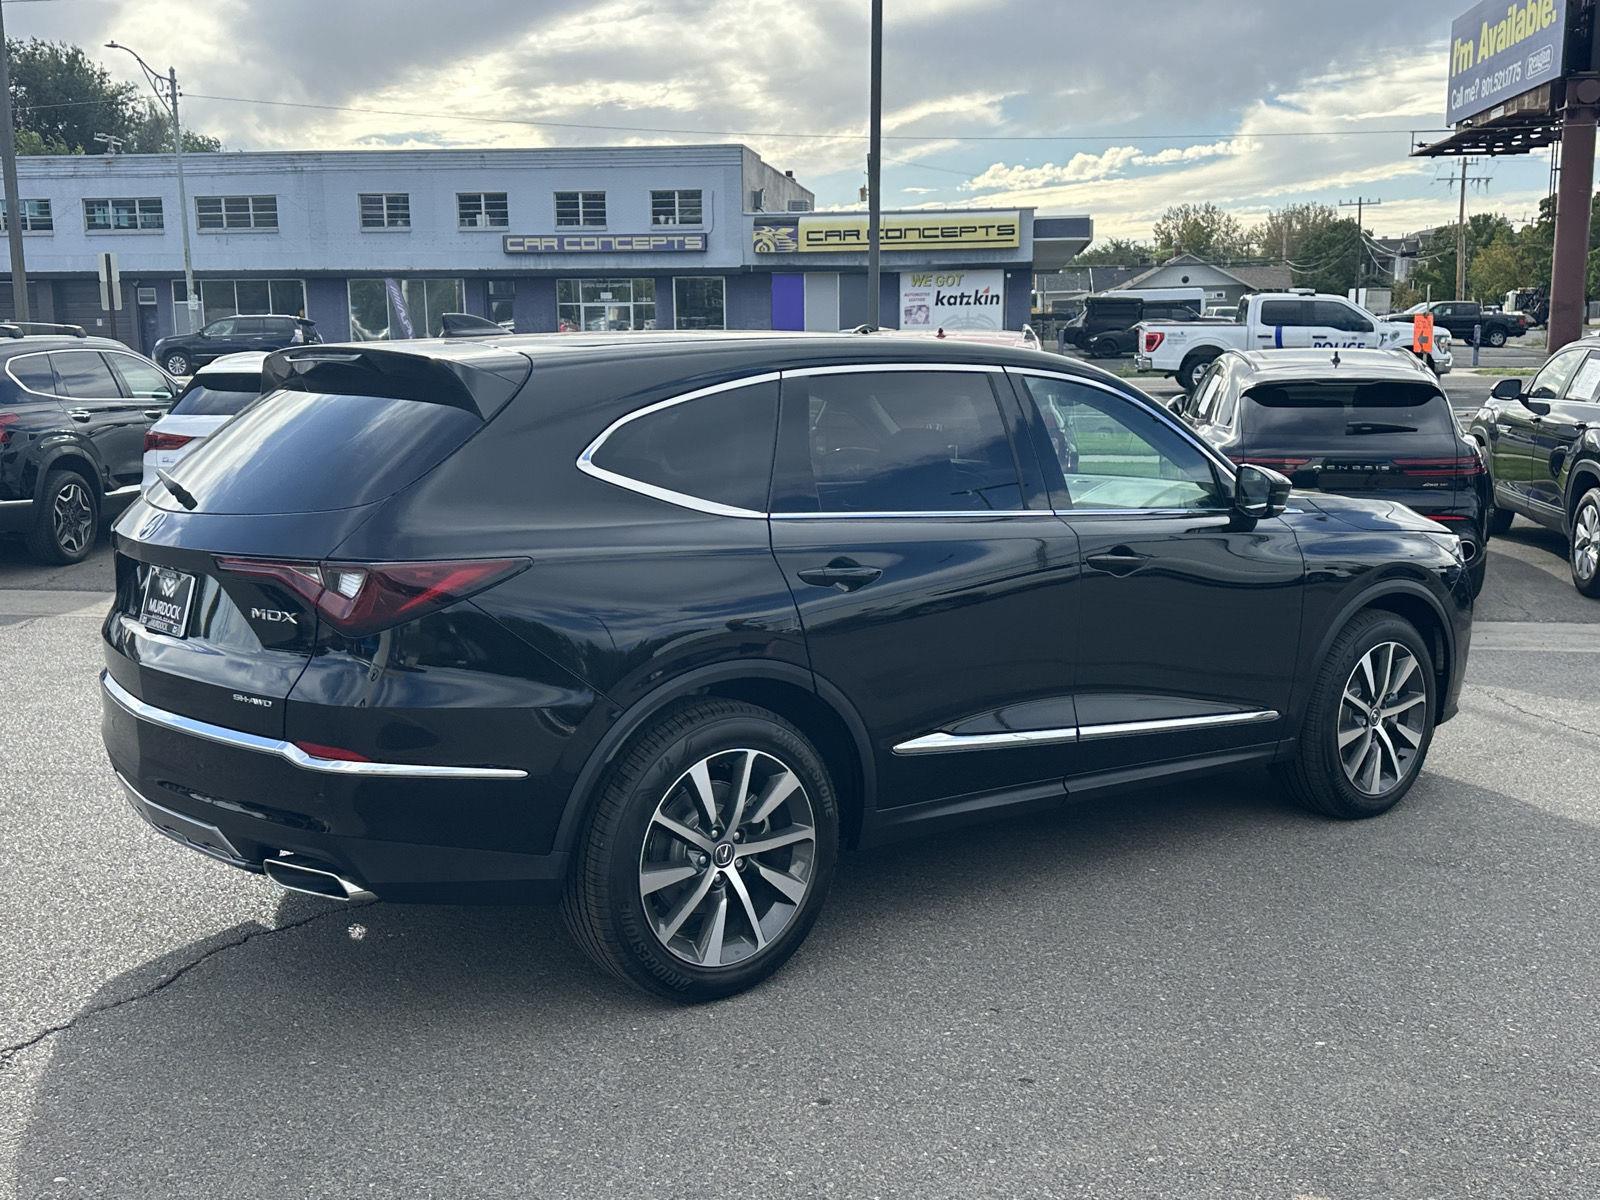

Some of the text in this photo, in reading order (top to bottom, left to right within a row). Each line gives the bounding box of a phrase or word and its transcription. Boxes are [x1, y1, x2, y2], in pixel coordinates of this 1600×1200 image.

[1452, 0, 1557, 77] I'm Available.
[1451, 85, 1464, 110] Call
[1464, 77, 1480, 106] me?
[506, 236, 702, 251] CAR CONCEPTS
[806, 229, 860, 242] CAR
[911, 272, 965, 288] WE GOT
[935, 287, 1000, 306] katzkin
[147, 597, 182, 620] MURDOCK
[250, 607, 298, 625] MDX
[232, 693, 272, 707] SH-AWD
